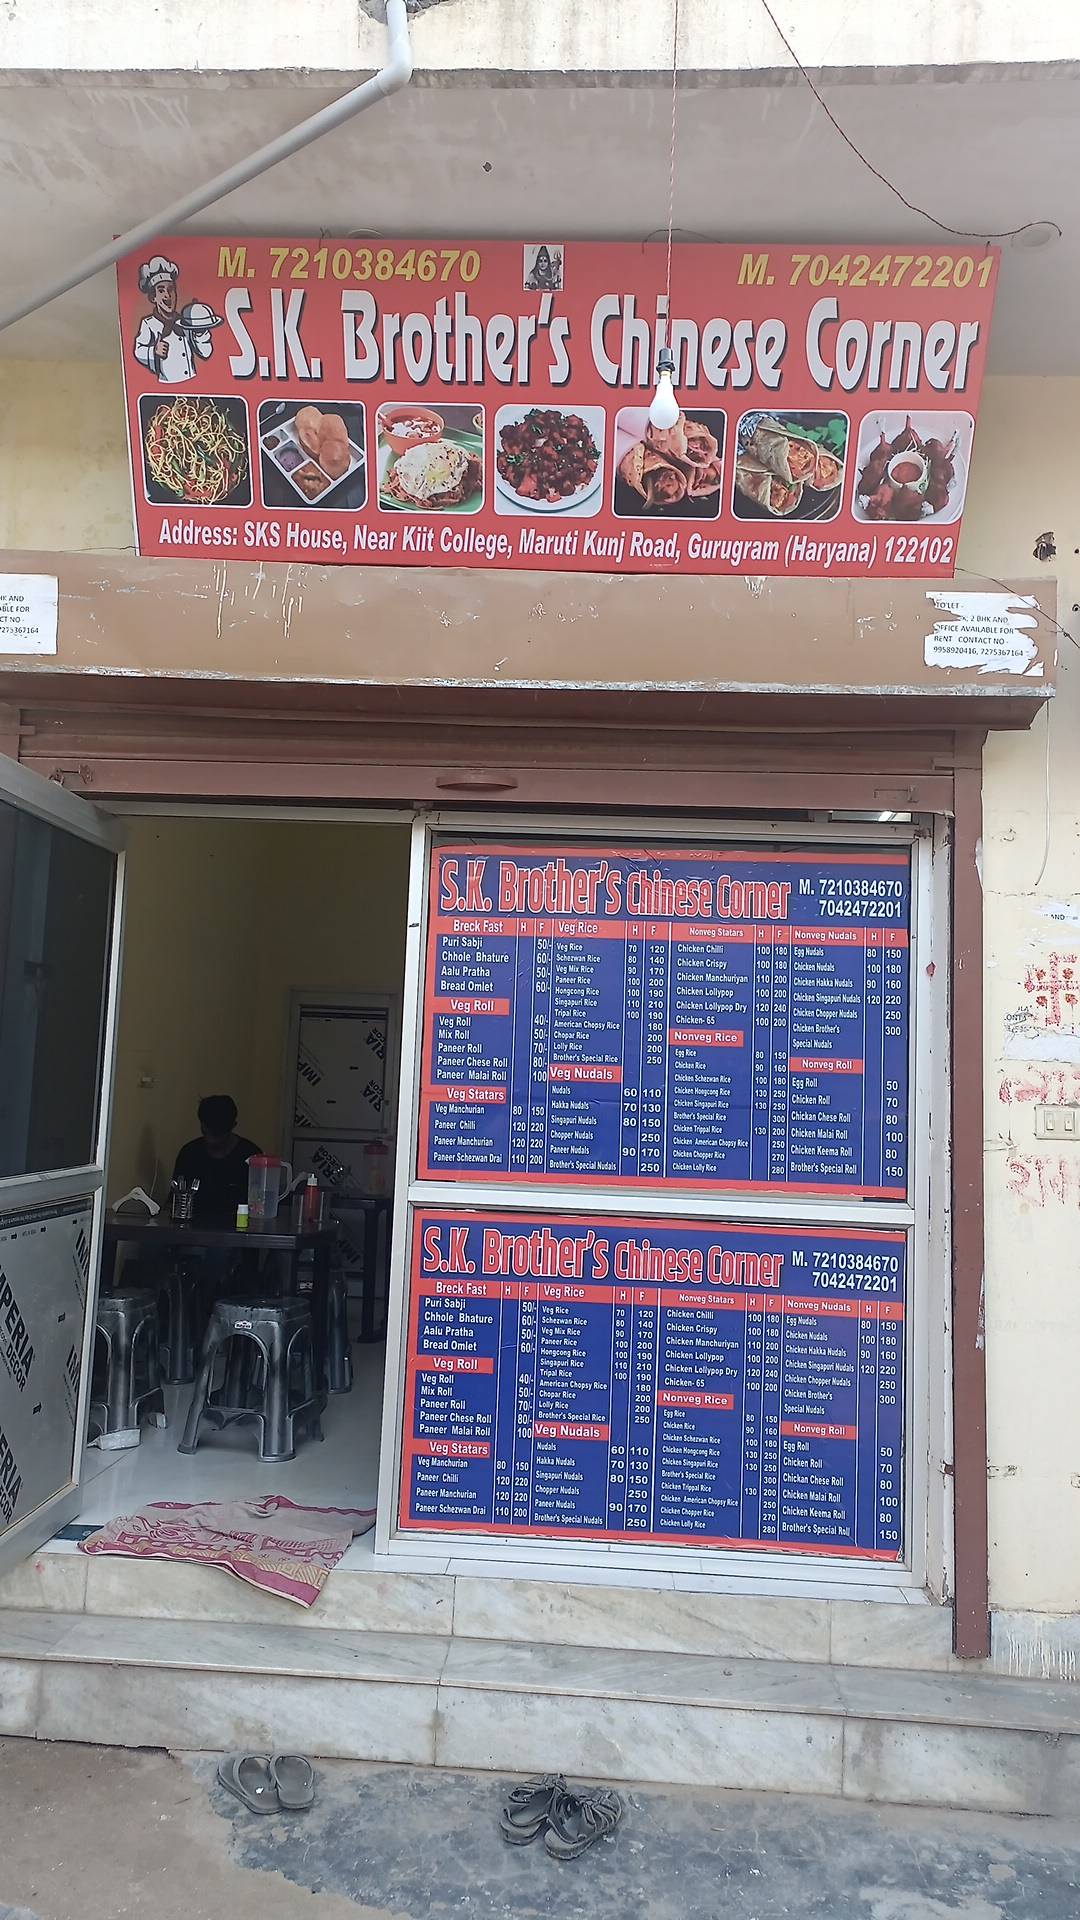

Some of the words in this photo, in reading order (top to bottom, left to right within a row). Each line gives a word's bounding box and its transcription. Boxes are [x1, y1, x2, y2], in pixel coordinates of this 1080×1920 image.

[217, 247, 255, 278] M.
[269, 248, 481, 282] 7210384670
[737, 254, 774, 286] M.
[789, 255, 994, 288] 7042472201
[224, 287, 321, 380] S.K.
[341, 289, 570, 384] Brother's
[590, 294, 787, 389] Chinese
[806, 298, 979, 391] Corner
[159, 519, 238, 546] Address:
[243, 521, 281, 547] SKS
[286, 522, 348, 554] House,
[354, 525, 397, 551] Near
[402, 525, 434, 552] Kiit
[440, 527, 512, 559] College,
[518, 528, 578, 555] Maruti
[583, 531, 625, 561] Kunj
[630, 532, 681, 561] Road,
[688, 535, 779, 565] Gurugram
[785, 536, 877, 568] (Haryana)
[884, 536, 954, 564] 122102
[441, 860, 492, 912] S.K.
[499, 859, 621, 916] Brother's
[717, 875, 791, 919] Corner
[799, 879, 815, 895] M.
[819, 879, 902, 897] 7210384670
[819, 900, 902, 918] 7042472201
[454, 920, 480, 932] Breck
[484, 920, 503, 932] Fast
[521, 922, 526, 932] H
[540, 923, 544, 932] F
[558, 921, 575, 935] Veg
[577, 922, 597, 933] Rice
[633, 925, 638, 935] H
[652, 926, 656, 935] F
[690, 928, 715, 937] Nonveg
[718, 928, 743, 937] Statars
[778, 930, 782, 938] F
[795, 931, 825, 941] Nonveg
[829, 932, 857, 940] Nudals
[891, 933, 895, 941] F
[443, 937, 460, 946] Puri
[462, 937, 482, 949] Sabji
[557, 943, 567, 952] Veg
[570, 943, 582, 951] Rice
[678, 944, 704, 953] Chicken
[706, 945, 723, 953] Chilli
[757, 946, 770, 954] 100
[775, 947, 787, 955] 180
[794, 947, 804, 957] Egg
[867, 949, 876, 957] 80
[442, 951, 470, 961] Chhole
[585, 955, 600, 963] Rice
[886, 950, 901, 958] 150
[441, 966, 460, 976] Aalu
[462, 966, 490, 977] Pratha
[441, 980, 465, 990] Bread
[467, 981, 493, 991] Omlet
[451, 1000, 470, 1013] Veg
[474, 1000, 494, 1011] Roll
[675, 1032, 711, 1043] Nonveg
[715, 1033, 737, 1042] Rice
[438, 1043, 465, 1052] Paneer
[468, 1044, 481, 1053] Roll
[803, 1059, 833, 1070] Nonveg
[836, 1061, 851, 1069] Roll
[550, 1067, 570, 1080] Veg
[574, 1068, 612, 1079] Nudals
[447, 1088, 465, 1101] Veg
[469, 1089, 503, 1100] Statars
[551, 1101, 567, 1110] Hakka
[570, 1101, 589, 1110] Nudals
[624, 1103, 636, 1112] 70
[642, 1104, 661, 1113] 130
[818, 1112, 837, 1122] Chese
[839, 1113, 850, 1122] Roll
[886, 1115, 897, 1125] 80
[424, 1226, 475, 1273] S.K.
[482, 1228, 609, 1279] Brother's
[707, 1245, 784, 1288] Corner
[792, 1251, 808, 1266] M.
[812, 1252, 899, 1272] 7210384670
[813, 1272, 897, 1291] 7042472201
[680, 1294, 706, 1304] Nonveg
[708, 1295, 734, 1304] Statars
[788, 1300, 818, 1311] Nonveg
[822, 1302, 851, 1312] Nudals
[424, 1312, 453, 1322] Chhole
[666, 1337, 693, 1346] Chicken
[748, 1341, 761, 1349] 110
[766, 1342, 778, 1350] 200
[535, 1424, 556, 1438] Veg
[561, 1425, 600, 1437] Nudals
[794, 1424, 826, 1435] Nonveg
[829, 1426, 844, 1435] Roll
[784, 1457, 808, 1467] Chicken
[810, 1459, 822, 1468] Roll
[881, 1464, 892, 1473] 70
[416, 1503, 438, 1512] Paneer
[496, 1507, 509, 1516] 110
[514, 1508, 527, 1517] 200
[783, 1522, 811, 1532] Brother's
[813, 1523, 836, 1535] Special
[839, 1526, 850, 1536] Roll
[880, 1530, 897, 1540] 150
